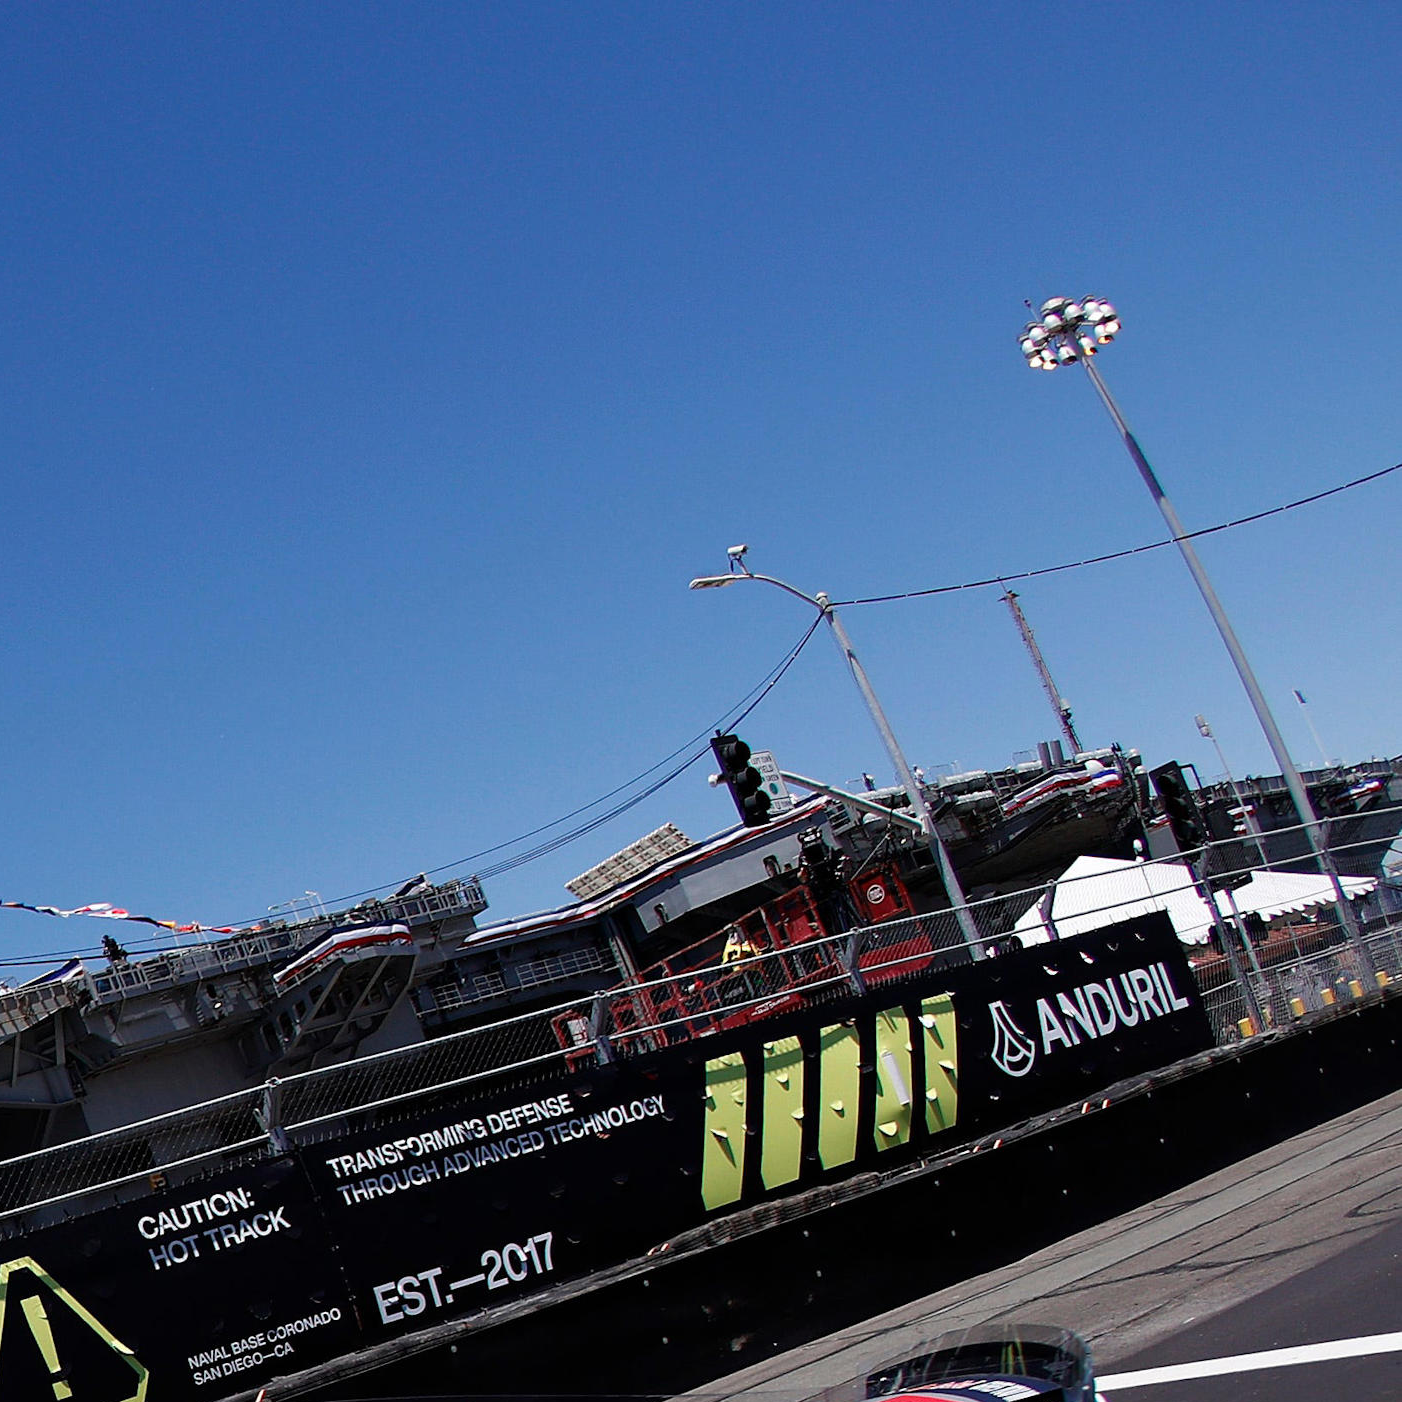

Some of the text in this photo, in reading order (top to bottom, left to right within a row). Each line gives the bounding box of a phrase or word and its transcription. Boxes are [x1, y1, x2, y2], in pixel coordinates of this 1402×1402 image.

[1035, 961, 1188, 1056] ANDURIL
[327, 1094, 575, 1178] TRANSFORMING DEFENSE
[337, 1093, 666, 1206] THROUGH ADVANCED TECHNOLOGY
[137, 1187, 256, 1240] CAUTION:
[149, 1206, 292, 1271] HOT TRACK
[188, 1307, 342, 1371] NAVAL BASE CORONADO
[193, 1365, 223, 1386] SAN
